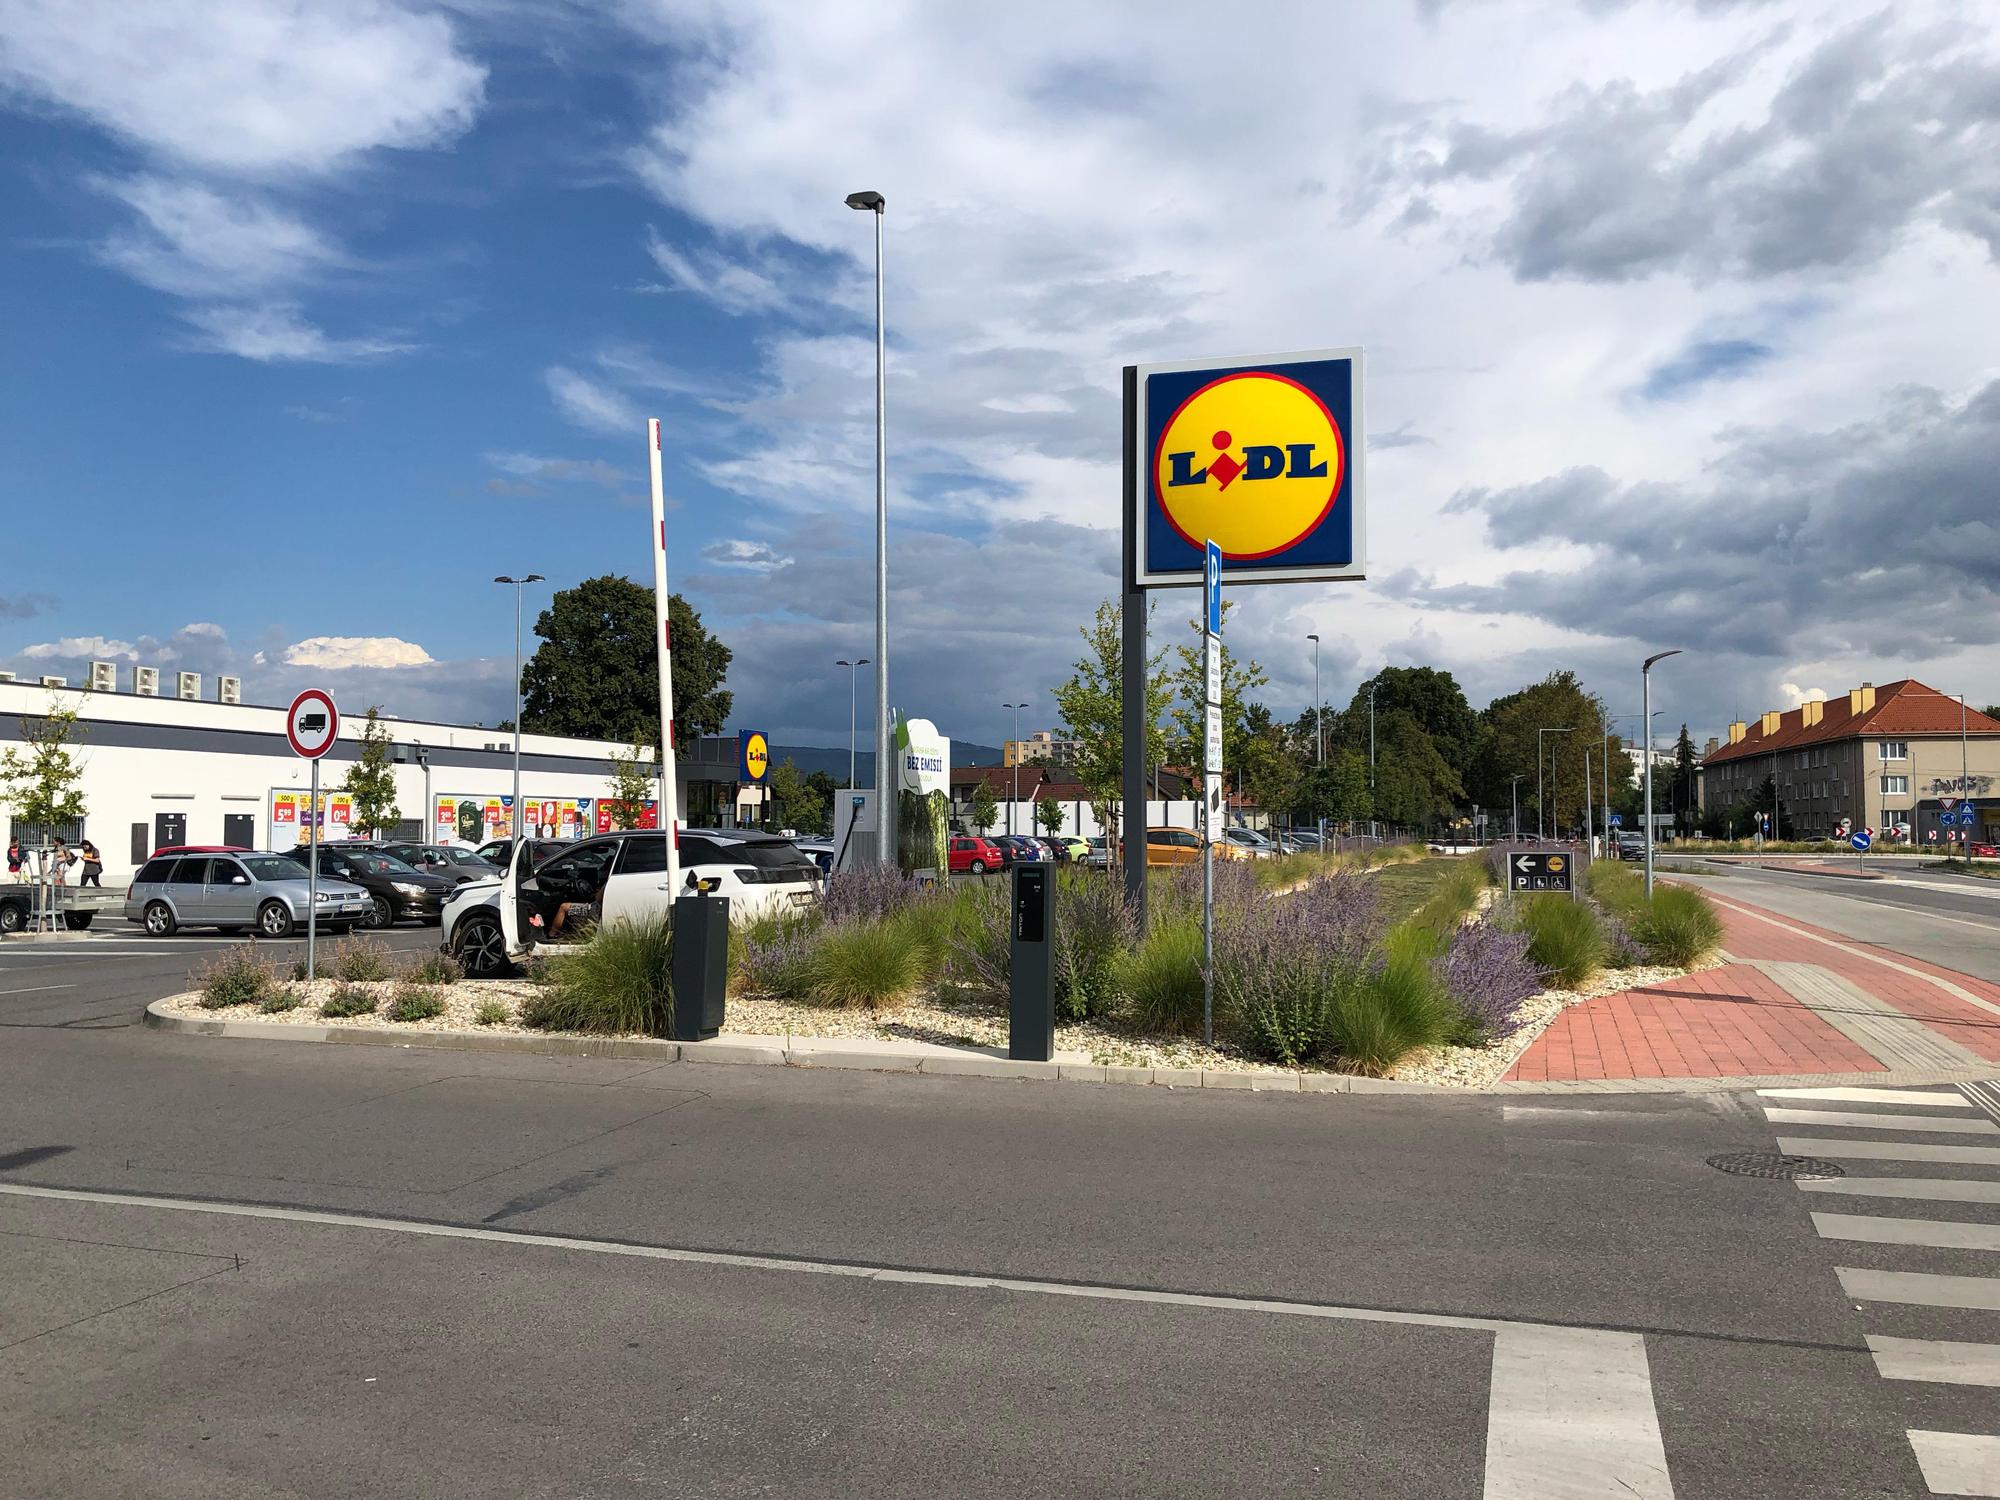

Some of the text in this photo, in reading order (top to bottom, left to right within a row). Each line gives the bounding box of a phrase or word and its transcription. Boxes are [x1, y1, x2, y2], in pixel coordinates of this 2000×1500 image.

[1211, 554, 1218, 604] P
[907, 755, 919, 771] BEZ
[1518, 877, 1527, 888] P
